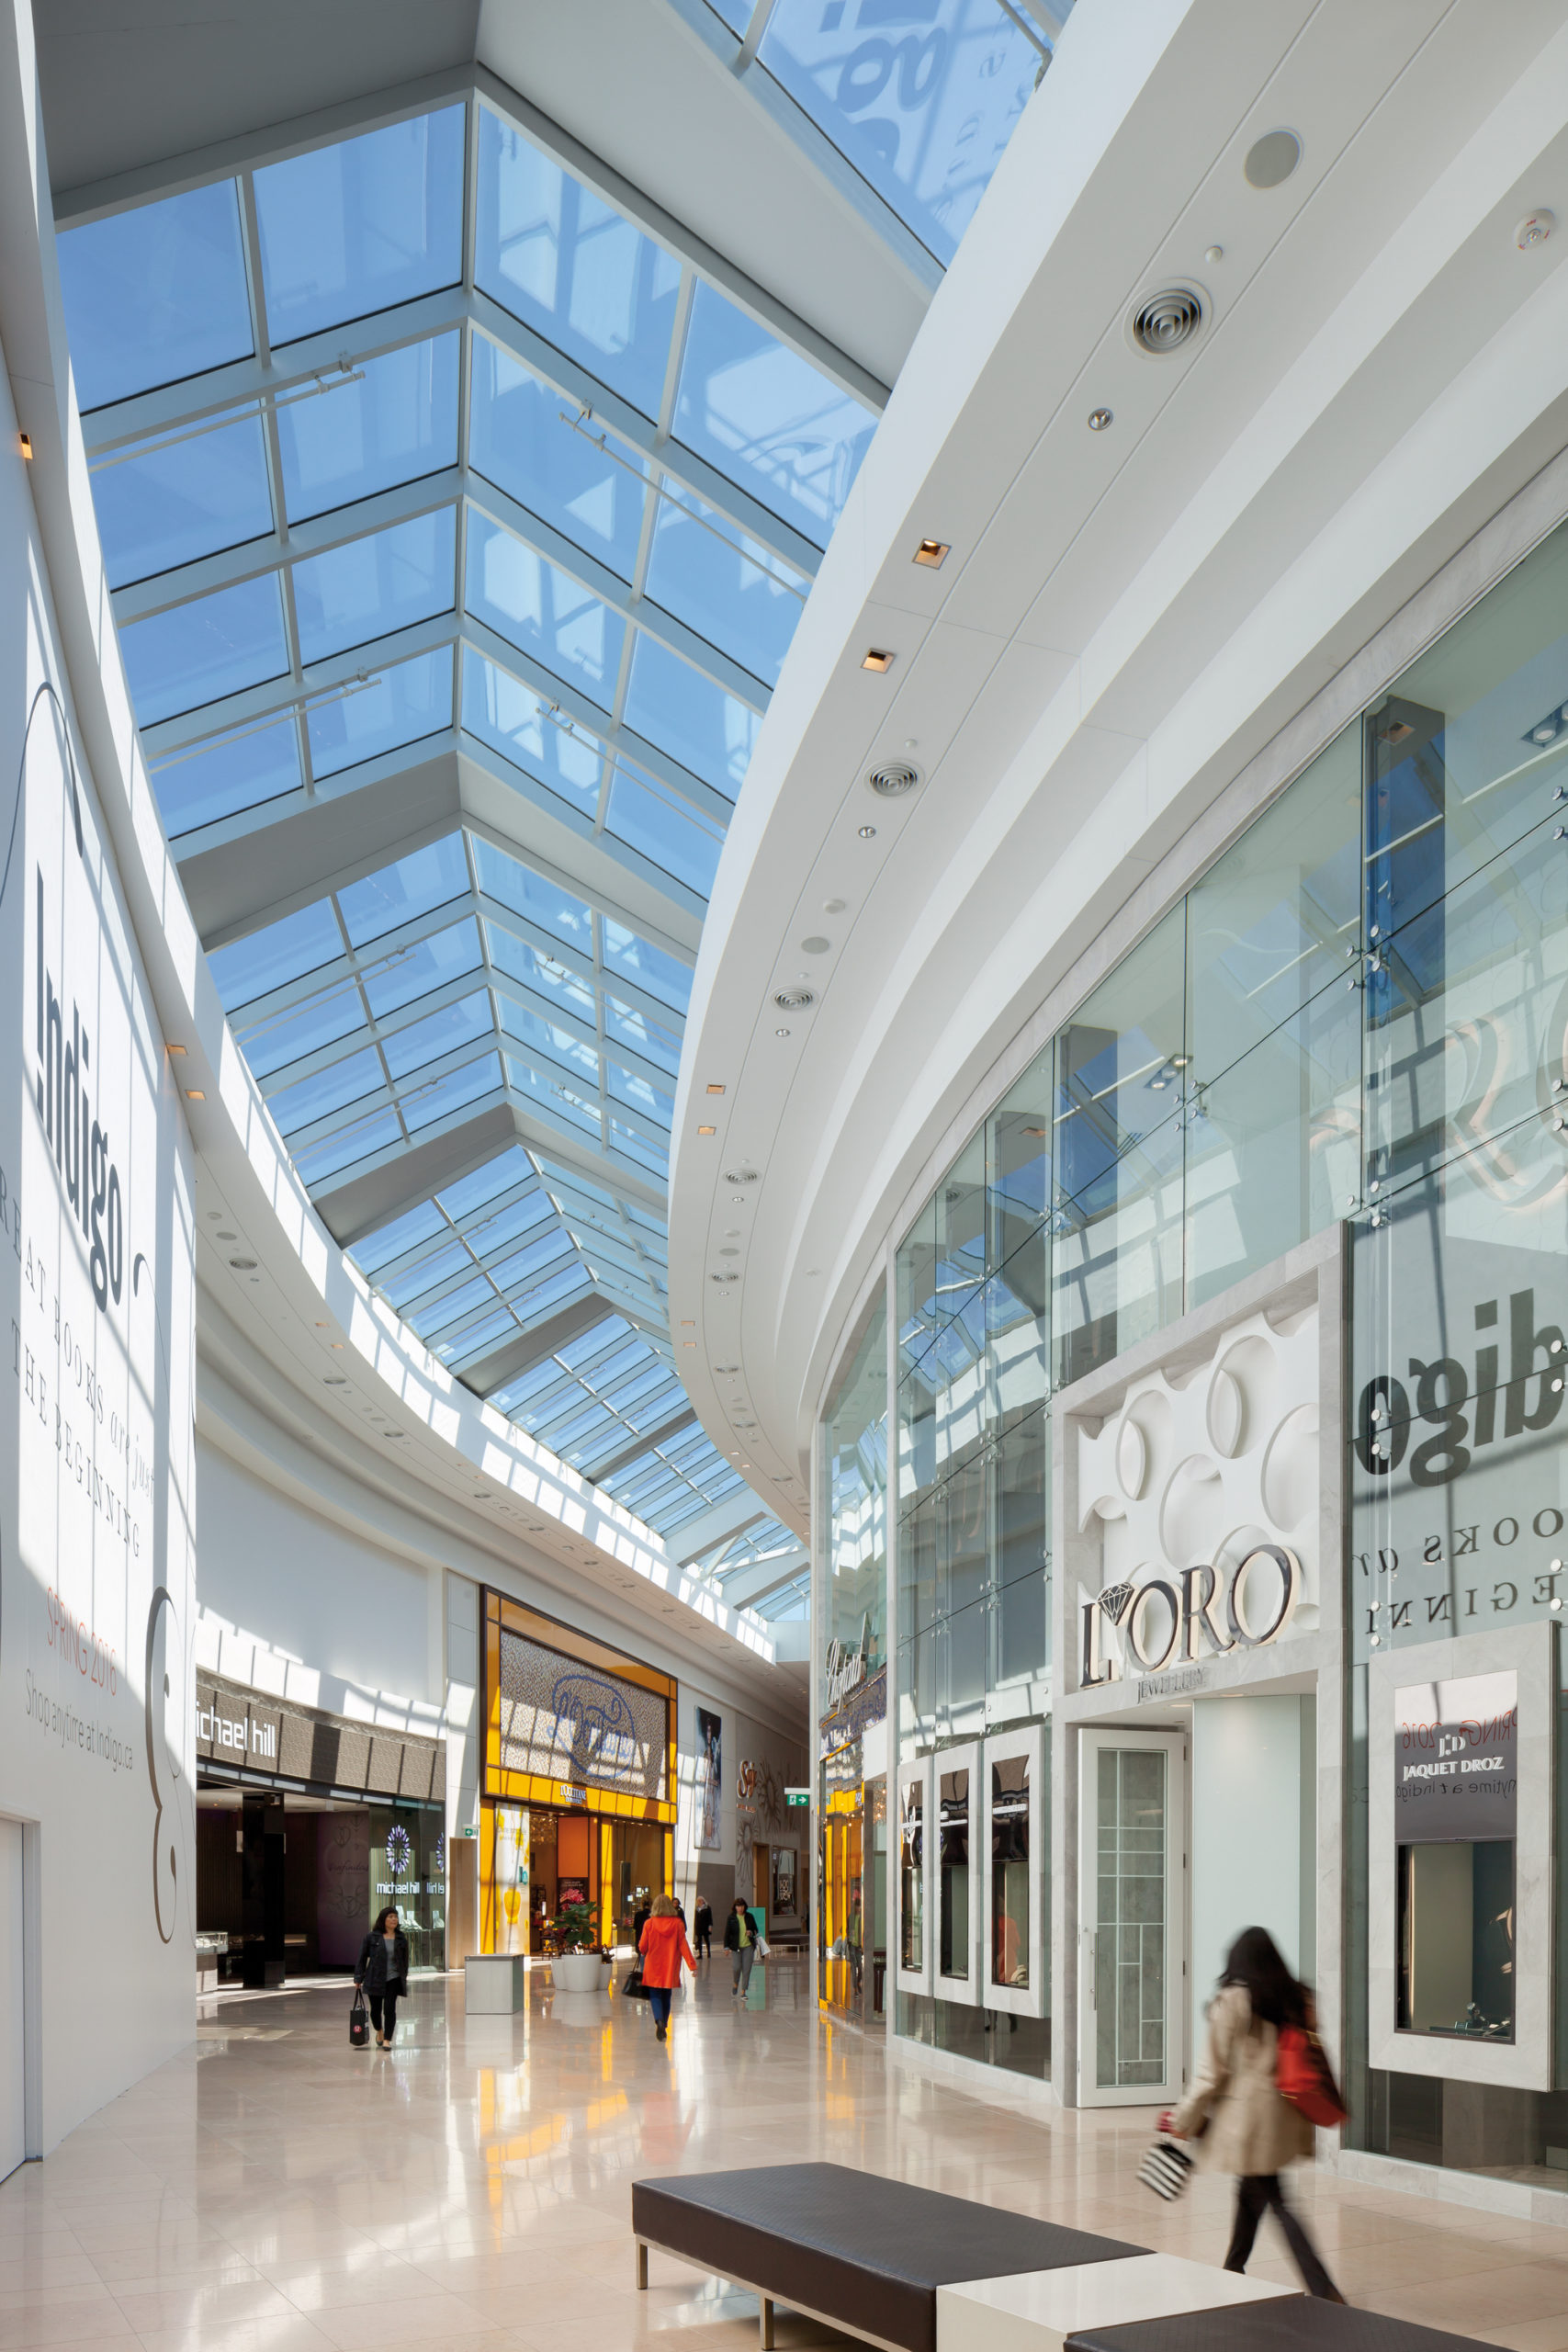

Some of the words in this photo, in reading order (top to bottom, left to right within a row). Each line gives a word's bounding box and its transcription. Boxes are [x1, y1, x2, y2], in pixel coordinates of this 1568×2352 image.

[37, 859, 122, 1313] Indigo
[11, 1317, 47, 1426] THE
[54, 1403, 140, 1557] BEGINNING
[54, 1295, 104, 1424] BOOKS
[110, 1411, 130, 1465] are
[132, 1434, 154, 1505] just
[47, 1587, 88, 1676] SPRING
[90, 1632, 118, 1697] 2016
[26, 1668, 51, 1736] Shop
[52, 1703, 85, 1748] anytime
[86, 1722, 95, 1754] at
[96, 1719, 133, 1772] Indigo.ca
[196, 1701, 248, 1751] ichael
[253, 1720, 276, 1758] hill
[1403, 1761, 1458, 1781] JAQUET
[1461, 1756, 1505, 1773] DROZ
[376, 1882, 409, 1894] michael
[409, 1882, 420, 1894] hill
